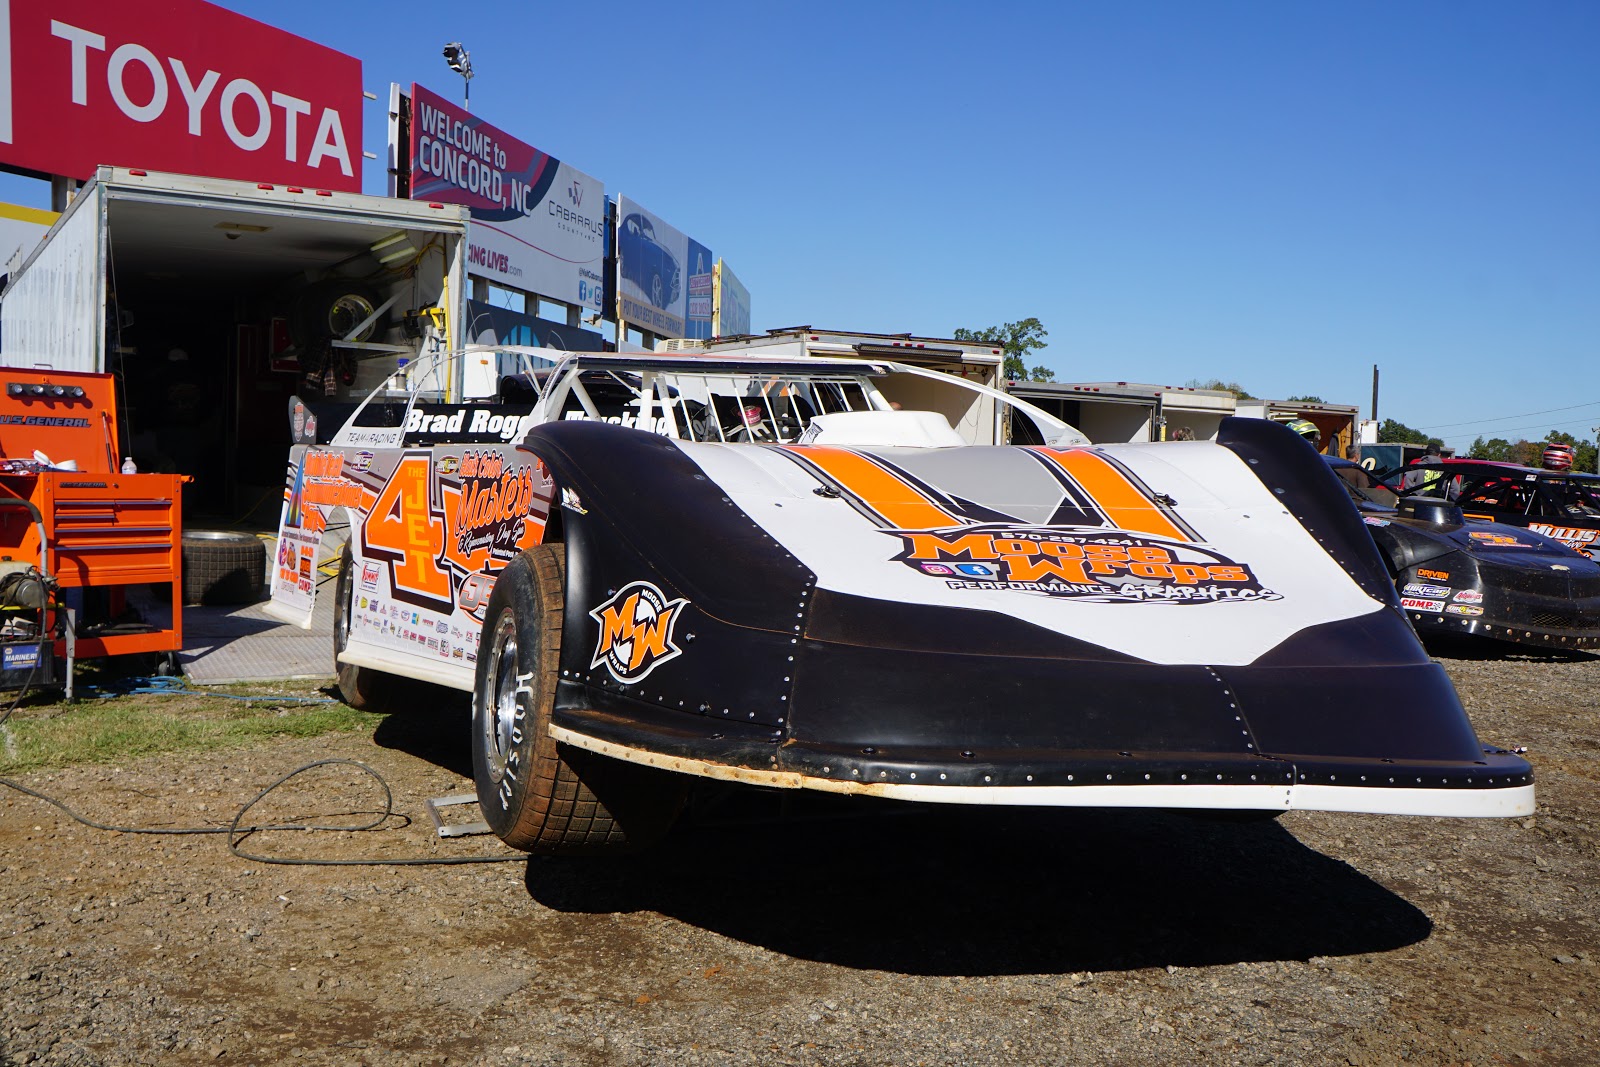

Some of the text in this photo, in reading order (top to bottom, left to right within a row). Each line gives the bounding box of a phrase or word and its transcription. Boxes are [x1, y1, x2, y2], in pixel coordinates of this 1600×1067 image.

[51, 19, 354, 178] TOYOTA
[420, 101, 507, 170] WELCOME to
[419, 135, 532, 217] CONCORD, NC
[548, 200, 603, 237] CABARRUS
[25, 415, 92, 428] GENERAL
[406, 409, 467, 433] Brad
[407, 467, 425, 478] THE
[455, 464, 533, 537] Masters
[362, 451, 454, 612] 4
[404, 478, 432, 584] JET
[495, 522, 511, 545] Day
[512, 520, 525, 542] Spa
[1001, 532, 1142, 546] 570-297-4241
[1529, 524, 1597, 542] MULLIS
[898, 533, 1171, 563] Moose
[1000, 554, 1250, 585] Wraps
[1417, 568, 1450, 579] DRIVEN
[949, 581, 1112, 594] PERFORMANCE
[1119, 583, 1285, 601] GRAPHICS
[641, 589, 663, 613] MOOSE
[1402, 599, 1433, 608] COMP
[600, 592, 672, 671] MW
[609, 652, 628, 675] WRAPS
